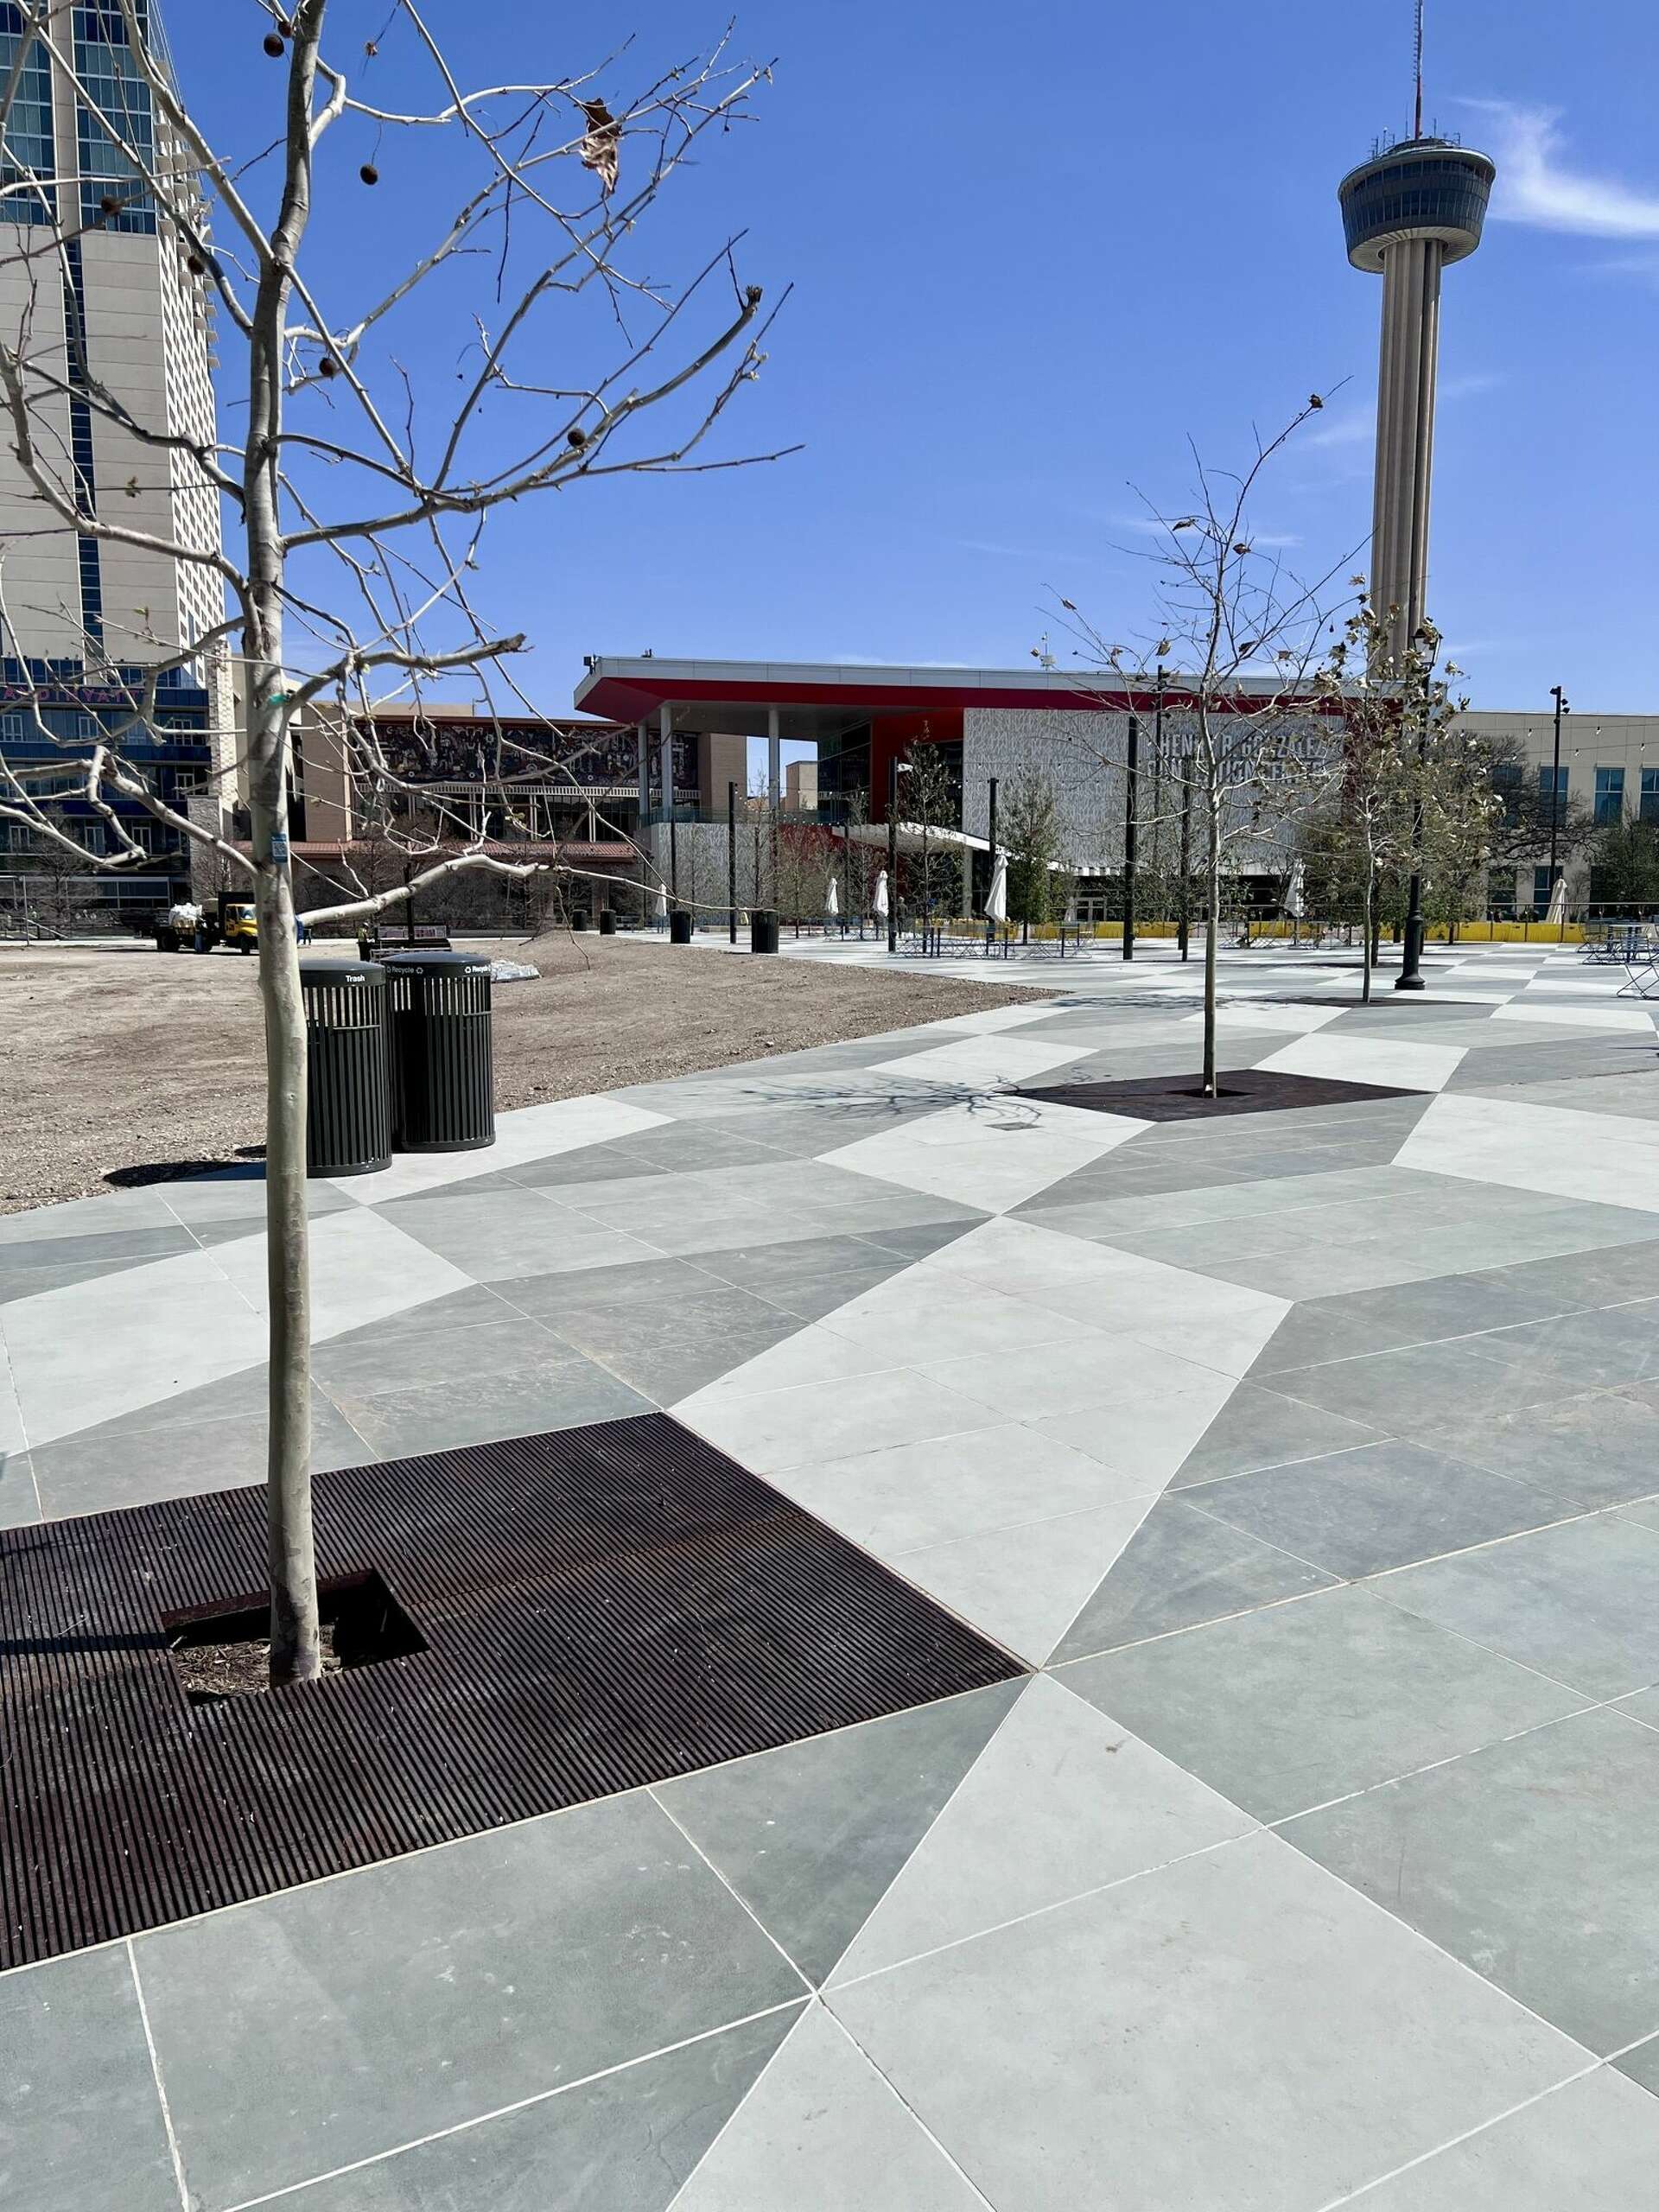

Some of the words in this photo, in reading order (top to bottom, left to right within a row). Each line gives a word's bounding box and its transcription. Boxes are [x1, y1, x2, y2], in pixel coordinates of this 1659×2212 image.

[1160, 734, 1215, 758] HEN
[1242, 734, 1326, 759] GOZALEZ
[1147, 760, 1256, 783] CONTION
[391, 966, 415, 975] Recycle
